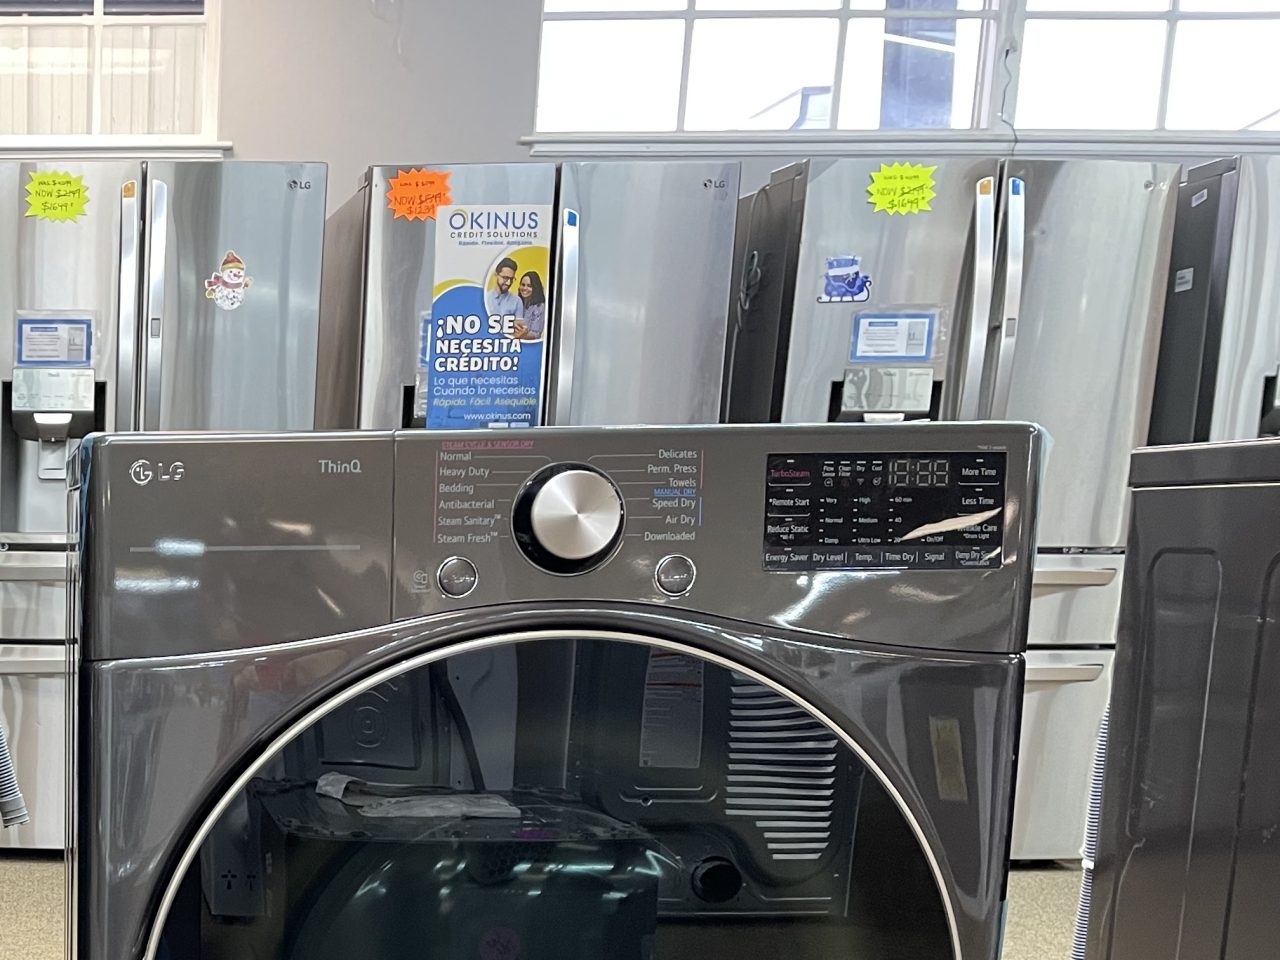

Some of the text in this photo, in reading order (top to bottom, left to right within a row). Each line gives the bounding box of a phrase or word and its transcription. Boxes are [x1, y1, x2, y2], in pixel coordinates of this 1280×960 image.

[300, 181, 311, 190] LG
[714, 180, 725, 189] LG
[34, 190, 54, 198] NOW
[393, 195, 416, 206] NOW
[449, 210, 539, 230] OKINUS
[436, 316, 516, 338] ¡NO SE
[436, 339, 522, 354] NECESITA
[434, 353, 518, 371] CRÉDITO!
[434, 376, 518, 388] Lo que necesitas
[434, 386, 536, 396] Cuando lo necesitas
[463, 411, 531, 421] www.okinus.com
[440, 452, 471, 461] Normal
[658, 449, 697, 459] Delicates
[318, 459, 362, 473] ThinQ
[647, 465, 697, 474] Perm. Press
[158, 462, 185, 481] LG
[440, 467, 489, 478] Heavy Duty
[771, 469, 810, 478] TurboSteam
[962, 467, 997, 476] More Time
[669, 478, 696, 487] Towels
[439, 484, 474, 494] Bedding
[439, 500, 494, 509] Antibacterial
[652, 499, 696, 509] Speed Dry
[794, 498, 810, 506] Start
[962, 497, 994, 505] Less Time
[438, 516, 462, 526] Steam
[665, 515, 696, 526] Air Dry
[767, 525, 808, 533] Reduce Static
[982, 524, 998, 532] Care
[437, 534, 465, 543] Steam
[644, 532, 696, 541] Downloaded
[765, 553, 808, 563] Energy Saver
[812, 553, 844, 563] Dry Level
[885, 553, 915, 562] Time Dry
[924, 553, 945, 563] Signal
